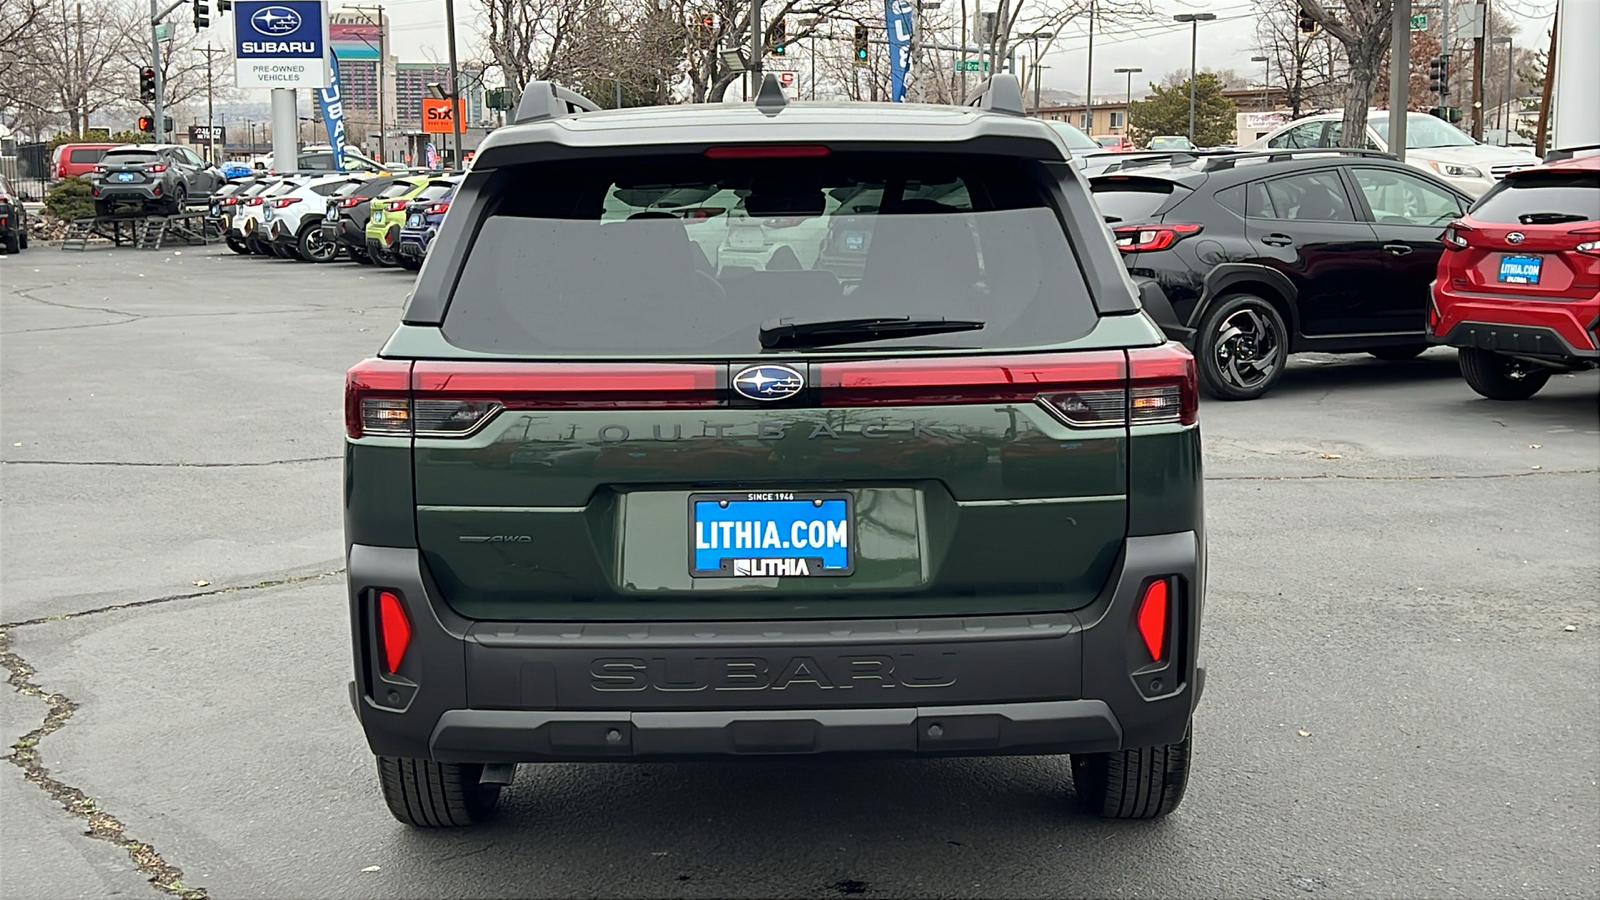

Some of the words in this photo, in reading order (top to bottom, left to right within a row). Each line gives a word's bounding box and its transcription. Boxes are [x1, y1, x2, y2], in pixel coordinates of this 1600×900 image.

[329, 13, 372, 25] tlantis
[242, 41, 315, 53] SUBARU
[253, 65, 305, 73] PRE-OWNED
[258, 74, 300, 82] VEHICLES
[1500, 263, 1540, 276] LITHIA.COM
[598, 420, 938, 442] OUTBACK
[747, 493, 773, 501] SINCE
[775, 493, 794, 501] 1946
[488, 535, 532, 543] AWD
[696, 520, 847, 549] LITHIA.COM
[751, 558, 810, 576] LITHIA
[590, 653, 957, 692] SUBARU
